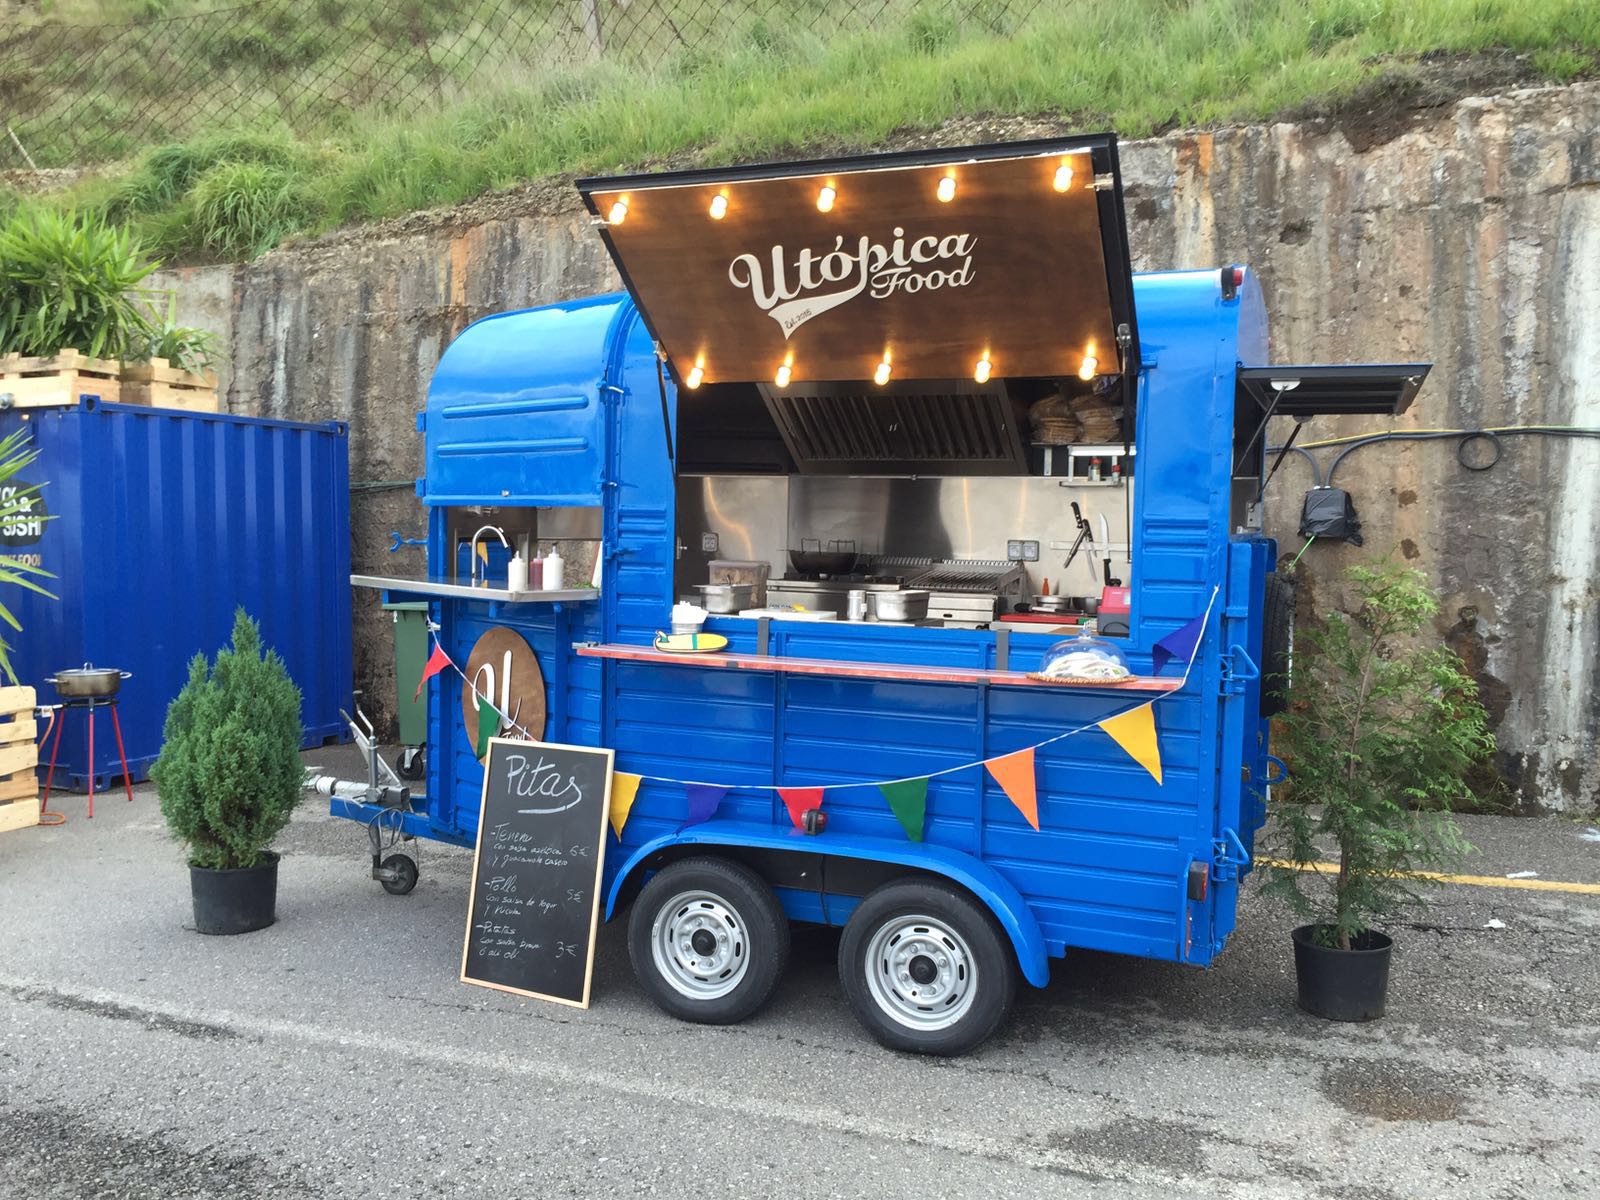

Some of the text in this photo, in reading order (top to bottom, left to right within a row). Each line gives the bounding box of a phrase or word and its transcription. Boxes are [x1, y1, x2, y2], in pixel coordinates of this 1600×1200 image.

[728, 227, 978, 312] Utópica
[870, 256, 977, 299] Food
[505, 754, 582, 810] Pitas
